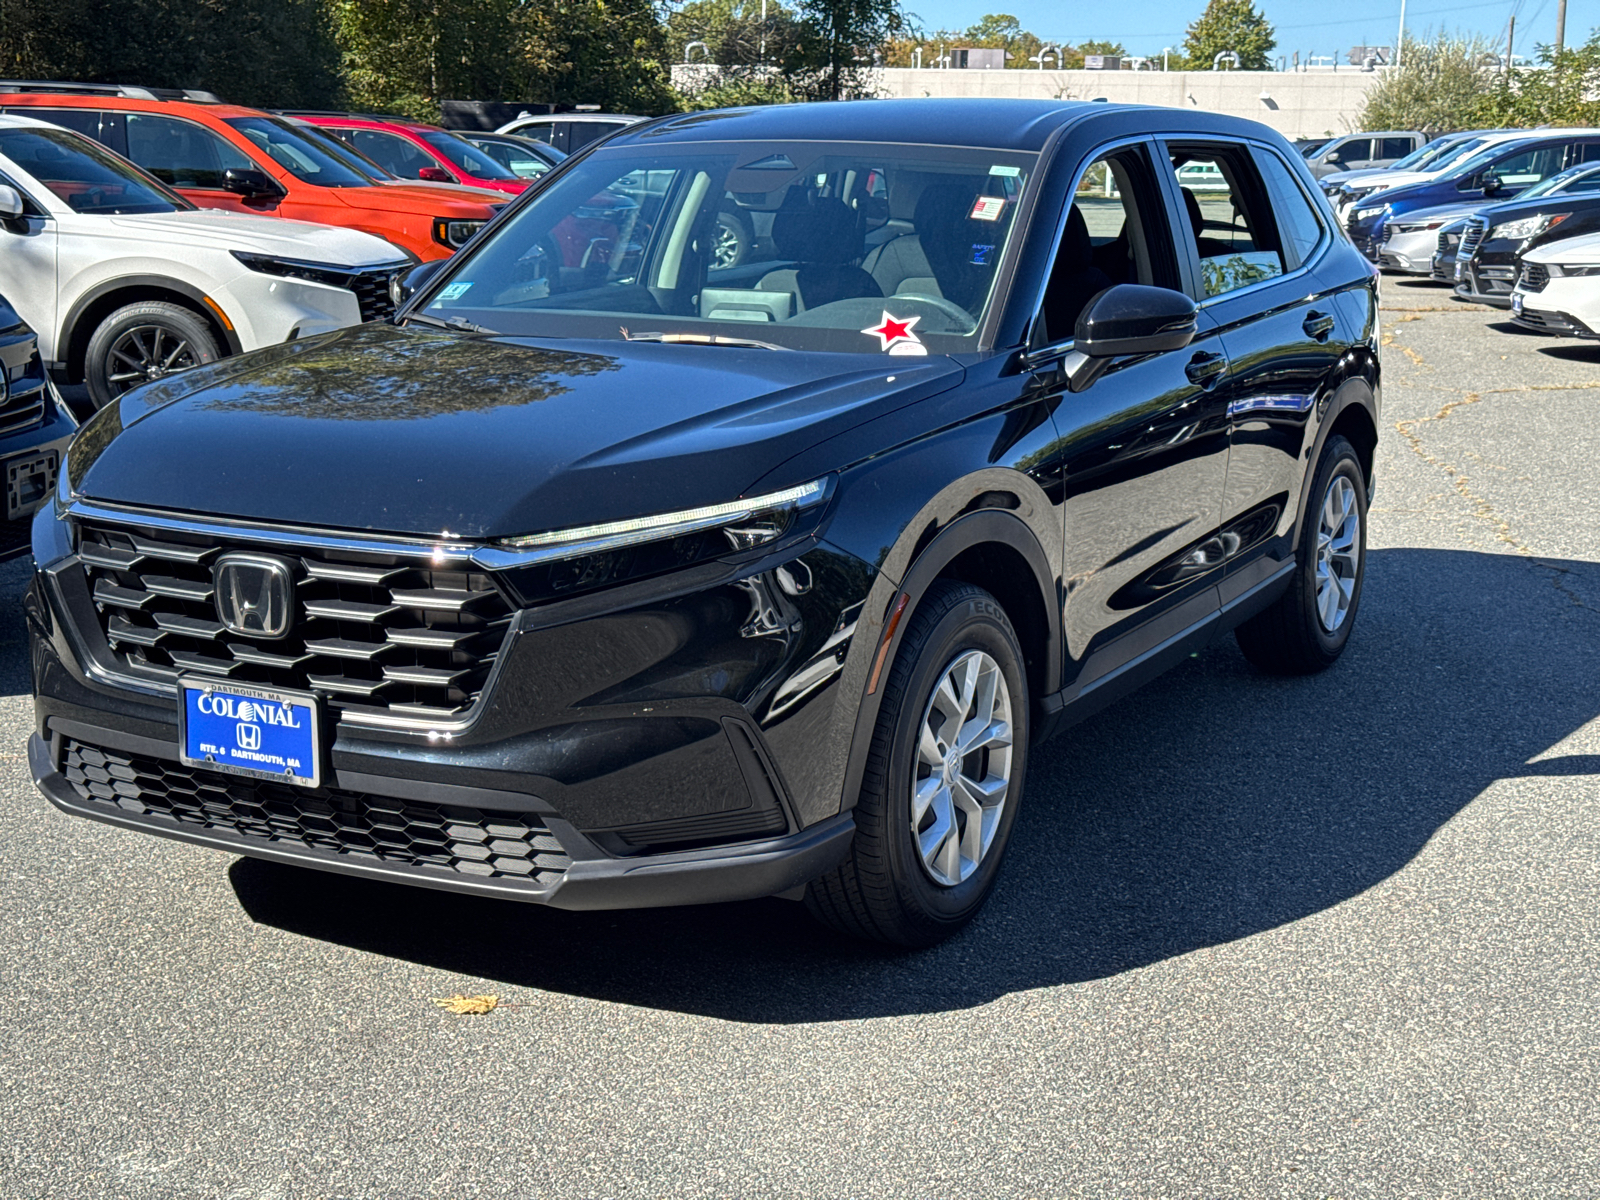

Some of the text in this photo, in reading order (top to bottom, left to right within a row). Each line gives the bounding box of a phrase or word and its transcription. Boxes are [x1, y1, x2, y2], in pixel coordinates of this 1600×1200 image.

[211, 684, 281, 701] DARTMOUTH, MA
[197, 693, 300, 729] COLONIAL
[200, 743, 301, 768] RTE. 6 DARTMOUTH, MA
